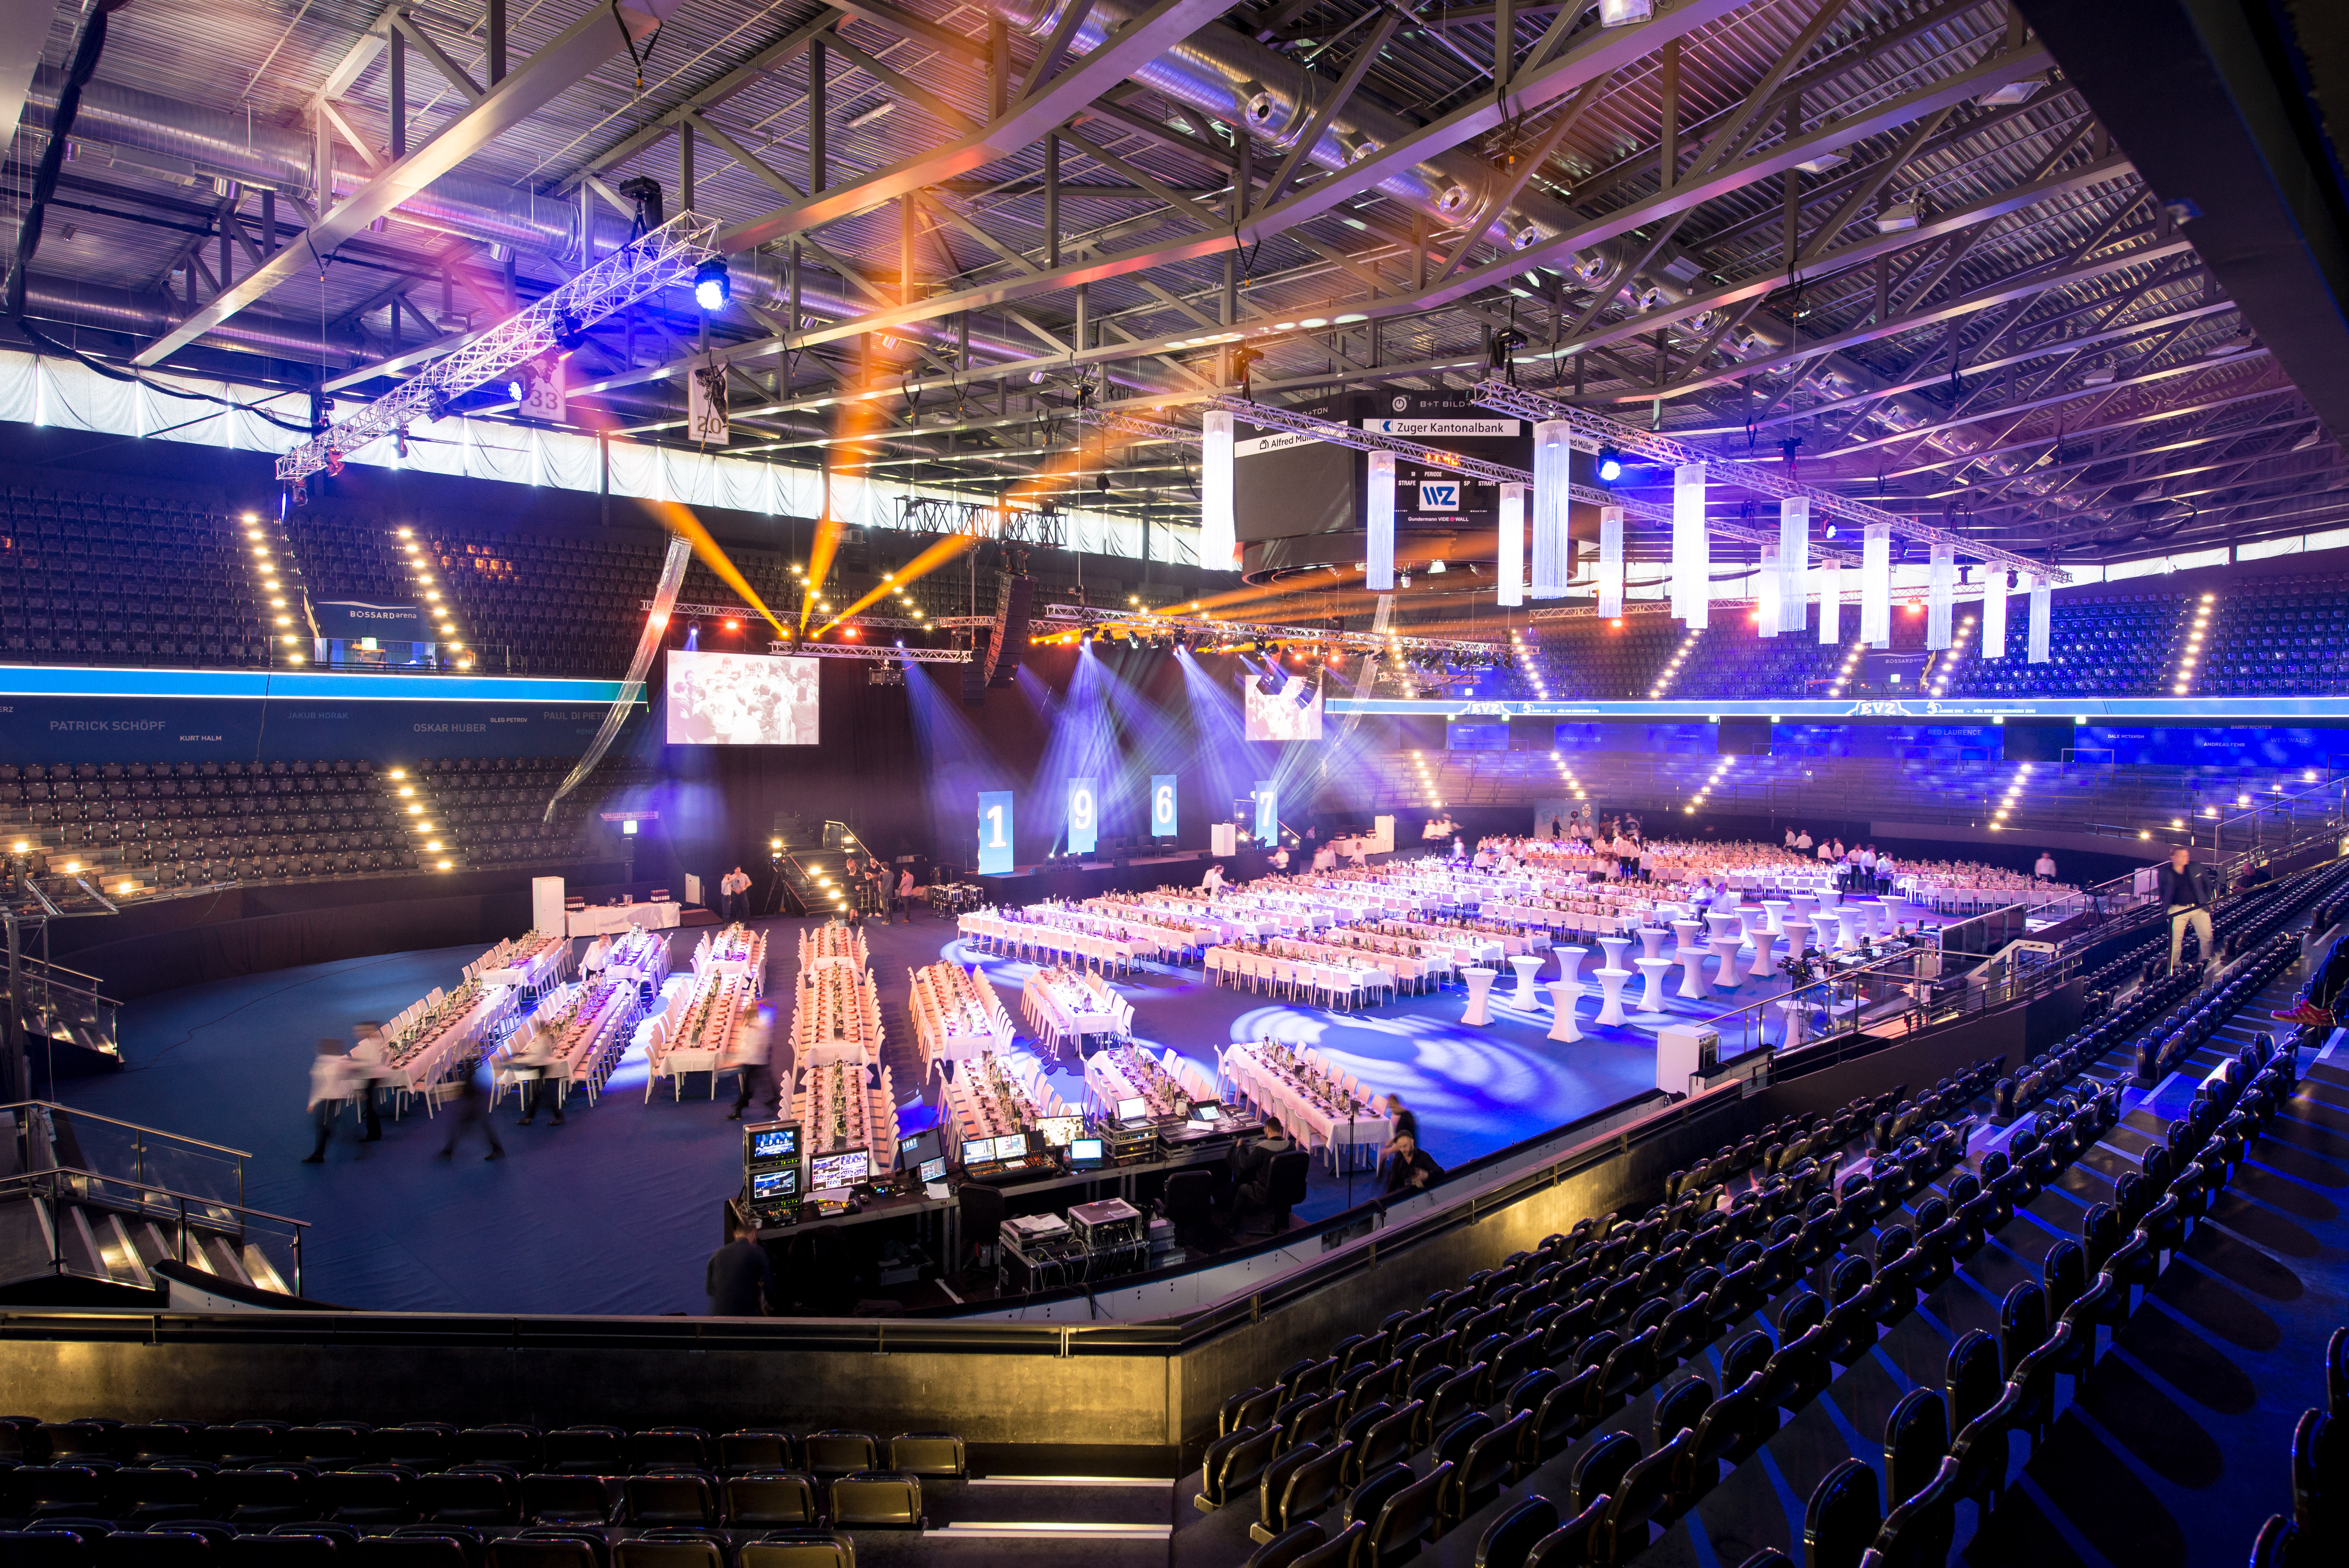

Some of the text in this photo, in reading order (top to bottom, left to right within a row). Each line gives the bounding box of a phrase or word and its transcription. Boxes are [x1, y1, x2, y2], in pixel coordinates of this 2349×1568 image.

[530, 389, 558, 410] 33
[697, 416, 722, 434] 20
[1397, 423, 1504, 434] Zuger Kantonalbank
[1271, 436, 1294, 448] Alfred
[1578, 440, 1593, 451] Müller
[350, 611, 395, 619] BOSSARD
[1471, 702, 1500, 714] EVZ
[1860, 702, 1896, 715] EVZ
[50, 719, 166, 731] PATRICK SCHÖPF
[413, 723, 487, 732] OSKAR HUBER
[987, 786, 1273, 848] 1 9 6 7
[902, 1138, 917, 1149] 1967
